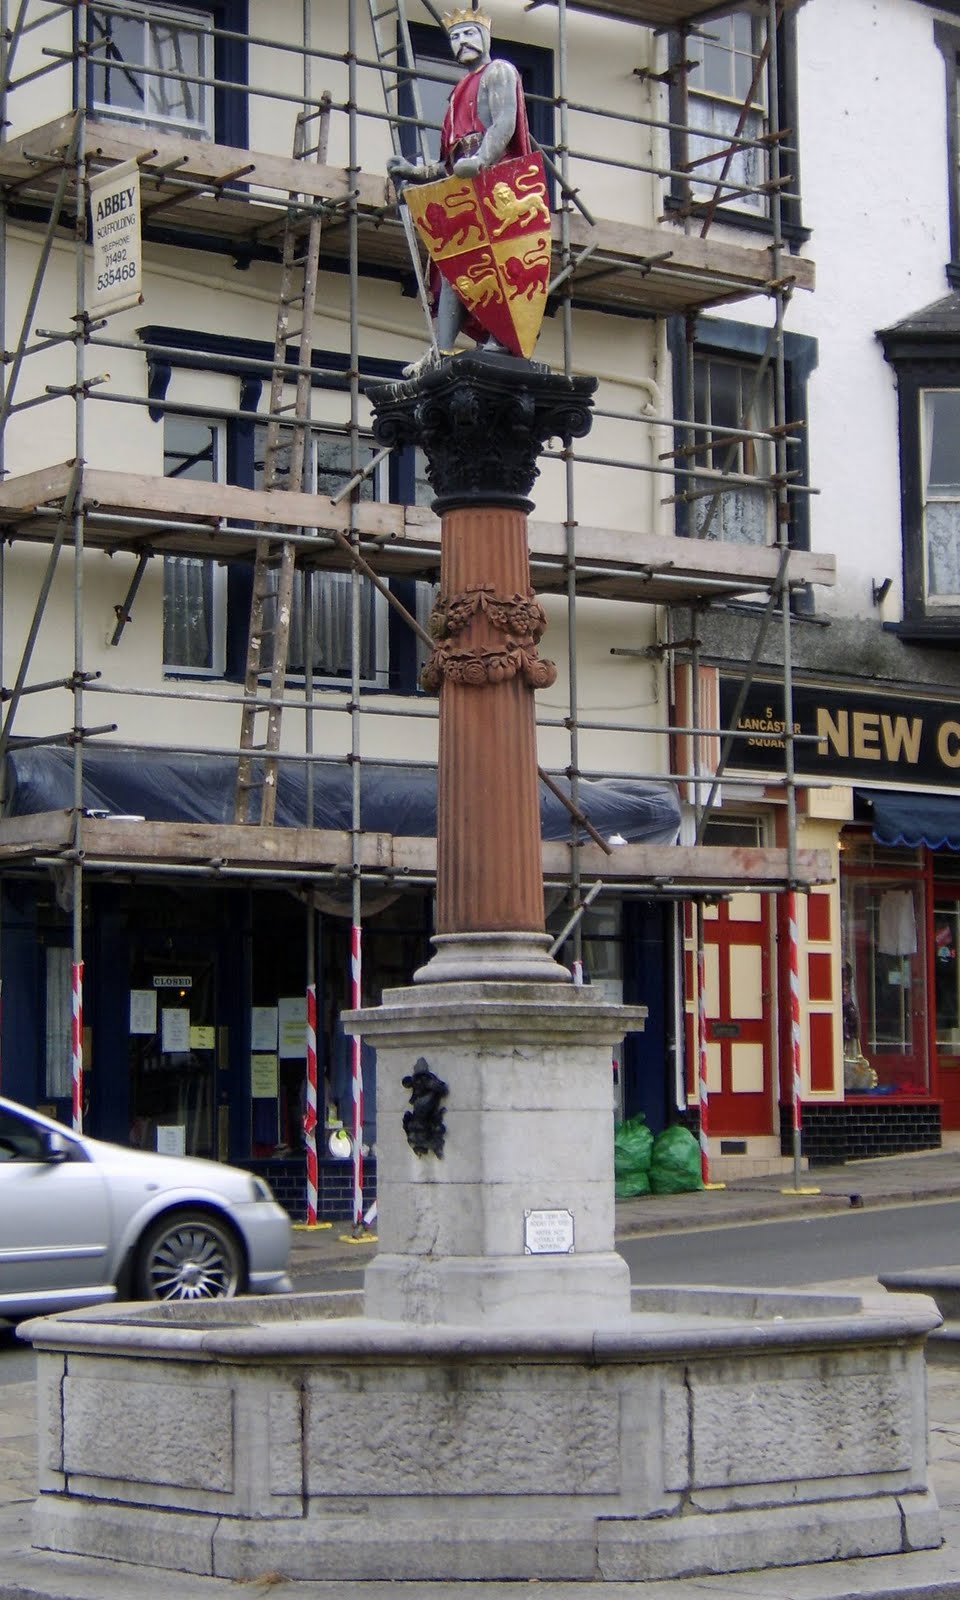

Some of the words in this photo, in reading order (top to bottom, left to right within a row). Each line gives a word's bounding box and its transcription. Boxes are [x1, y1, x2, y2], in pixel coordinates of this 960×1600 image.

[96, 187, 136, 222] ABBEY
[97, 213, 136, 240] SCAFFOLDING
[101, 235, 131, 253] TELEPHONE
[105, 249, 127, 267] 01492
[97, 262, 136, 291] 535468
[766, 707, 773, 719] 5
[738, 718, 801, 734] LANCASTR
[748, 736, 788, 749] SQUAR
[817, 708, 923, 764] NEW
[154, 977, 191, 986] CLOSED
